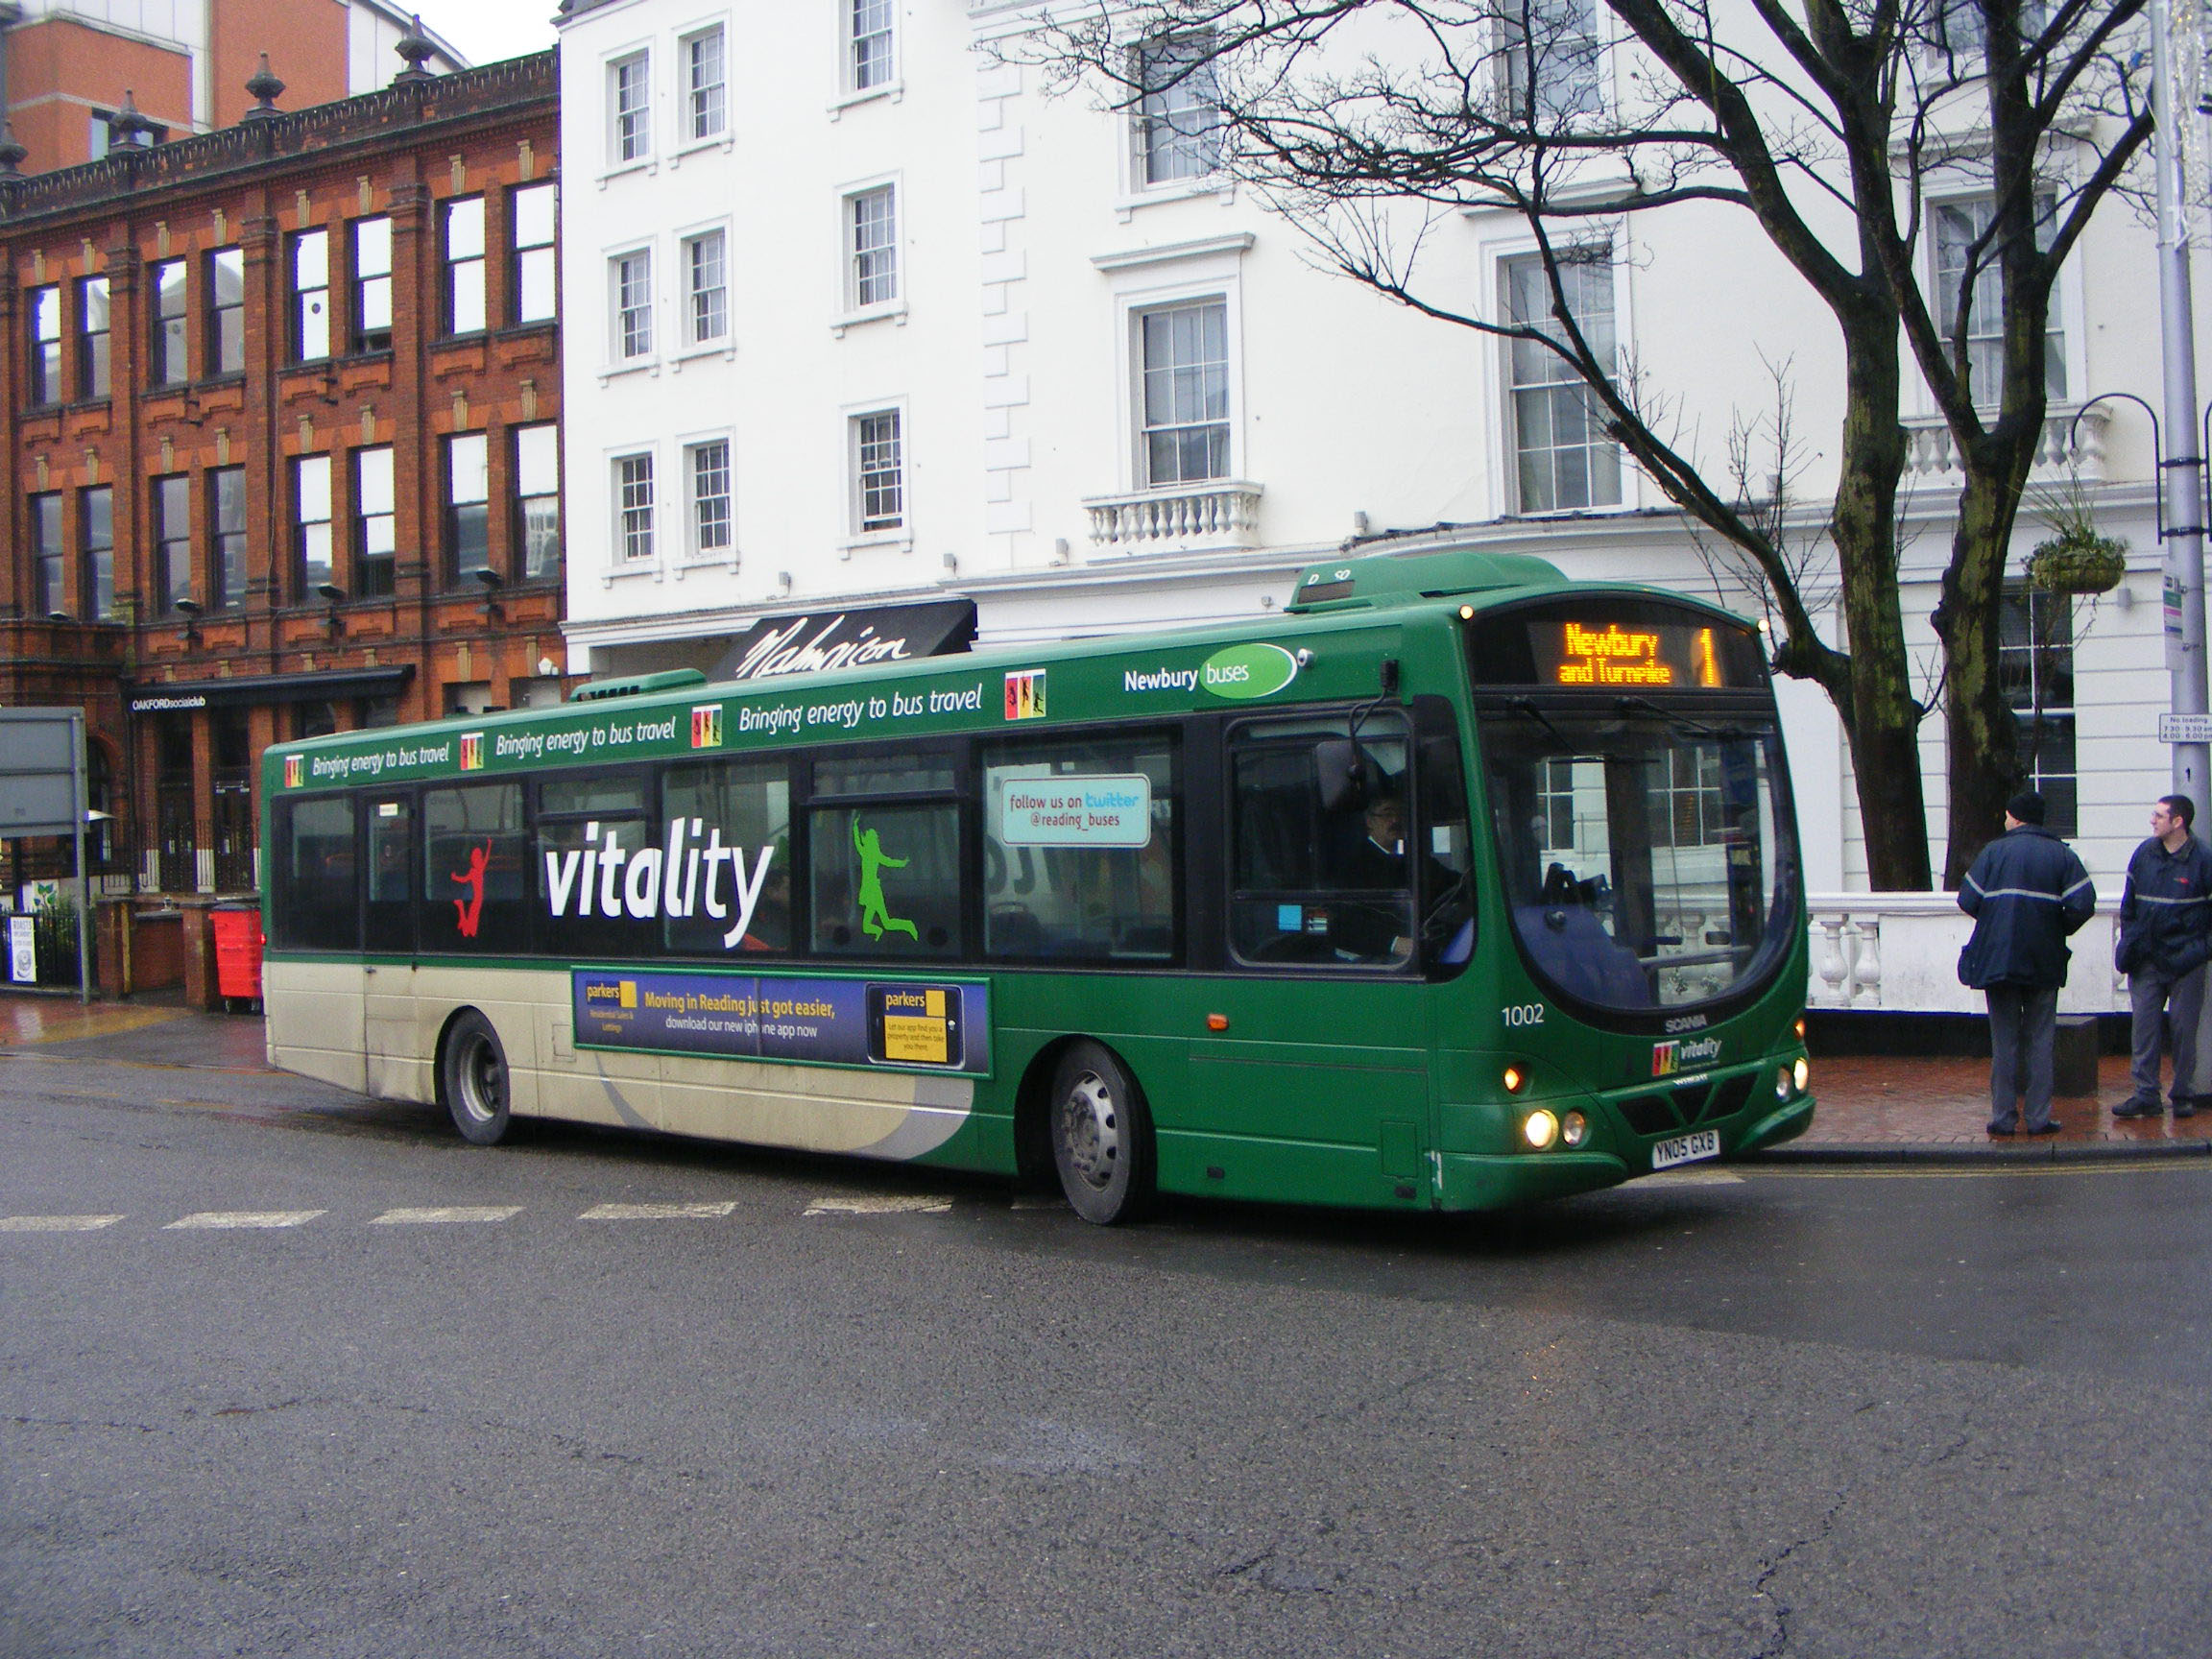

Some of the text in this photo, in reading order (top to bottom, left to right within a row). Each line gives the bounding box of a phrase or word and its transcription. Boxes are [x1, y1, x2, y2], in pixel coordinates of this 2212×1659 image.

[1565, 623, 1715, 685] Newbury 1
[1124, 662, 1249, 694] Newbury buses
[1559, 658, 1594, 684] and
[738, 683, 983, 734] Bringing energy to bus travel
[495, 715, 676, 760] Bringing energy to bus travel
[312, 742, 449, 780] Bringing energy to bus travel
[1009, 792, 1140, 811] follow us on twitter
[1030, 812, 1120, 832] @reading_buses
[545, 816, 775, 950] vitality
[586, 982, 620, 1003] parkers
[885, 990, 926, 1011] parkers
[644, 992, 836, 1021] Moving in Reading just got easier,
[1502, 1003, 1545, 1026] 1002
[665, 1015, 707, 1030] download
[709, 1021, 723, 1031] our
[724, 1022, 743, 1032] new
[777, 1023, 795, 1039] app
[796, 1024, 818, 1038] now
[1665, 1014, 1708, 1033] SCANIA
[1680, 1037, 1722, 1060] vitality
[1656, 1132, 1715, 1163] YN05 GXB
